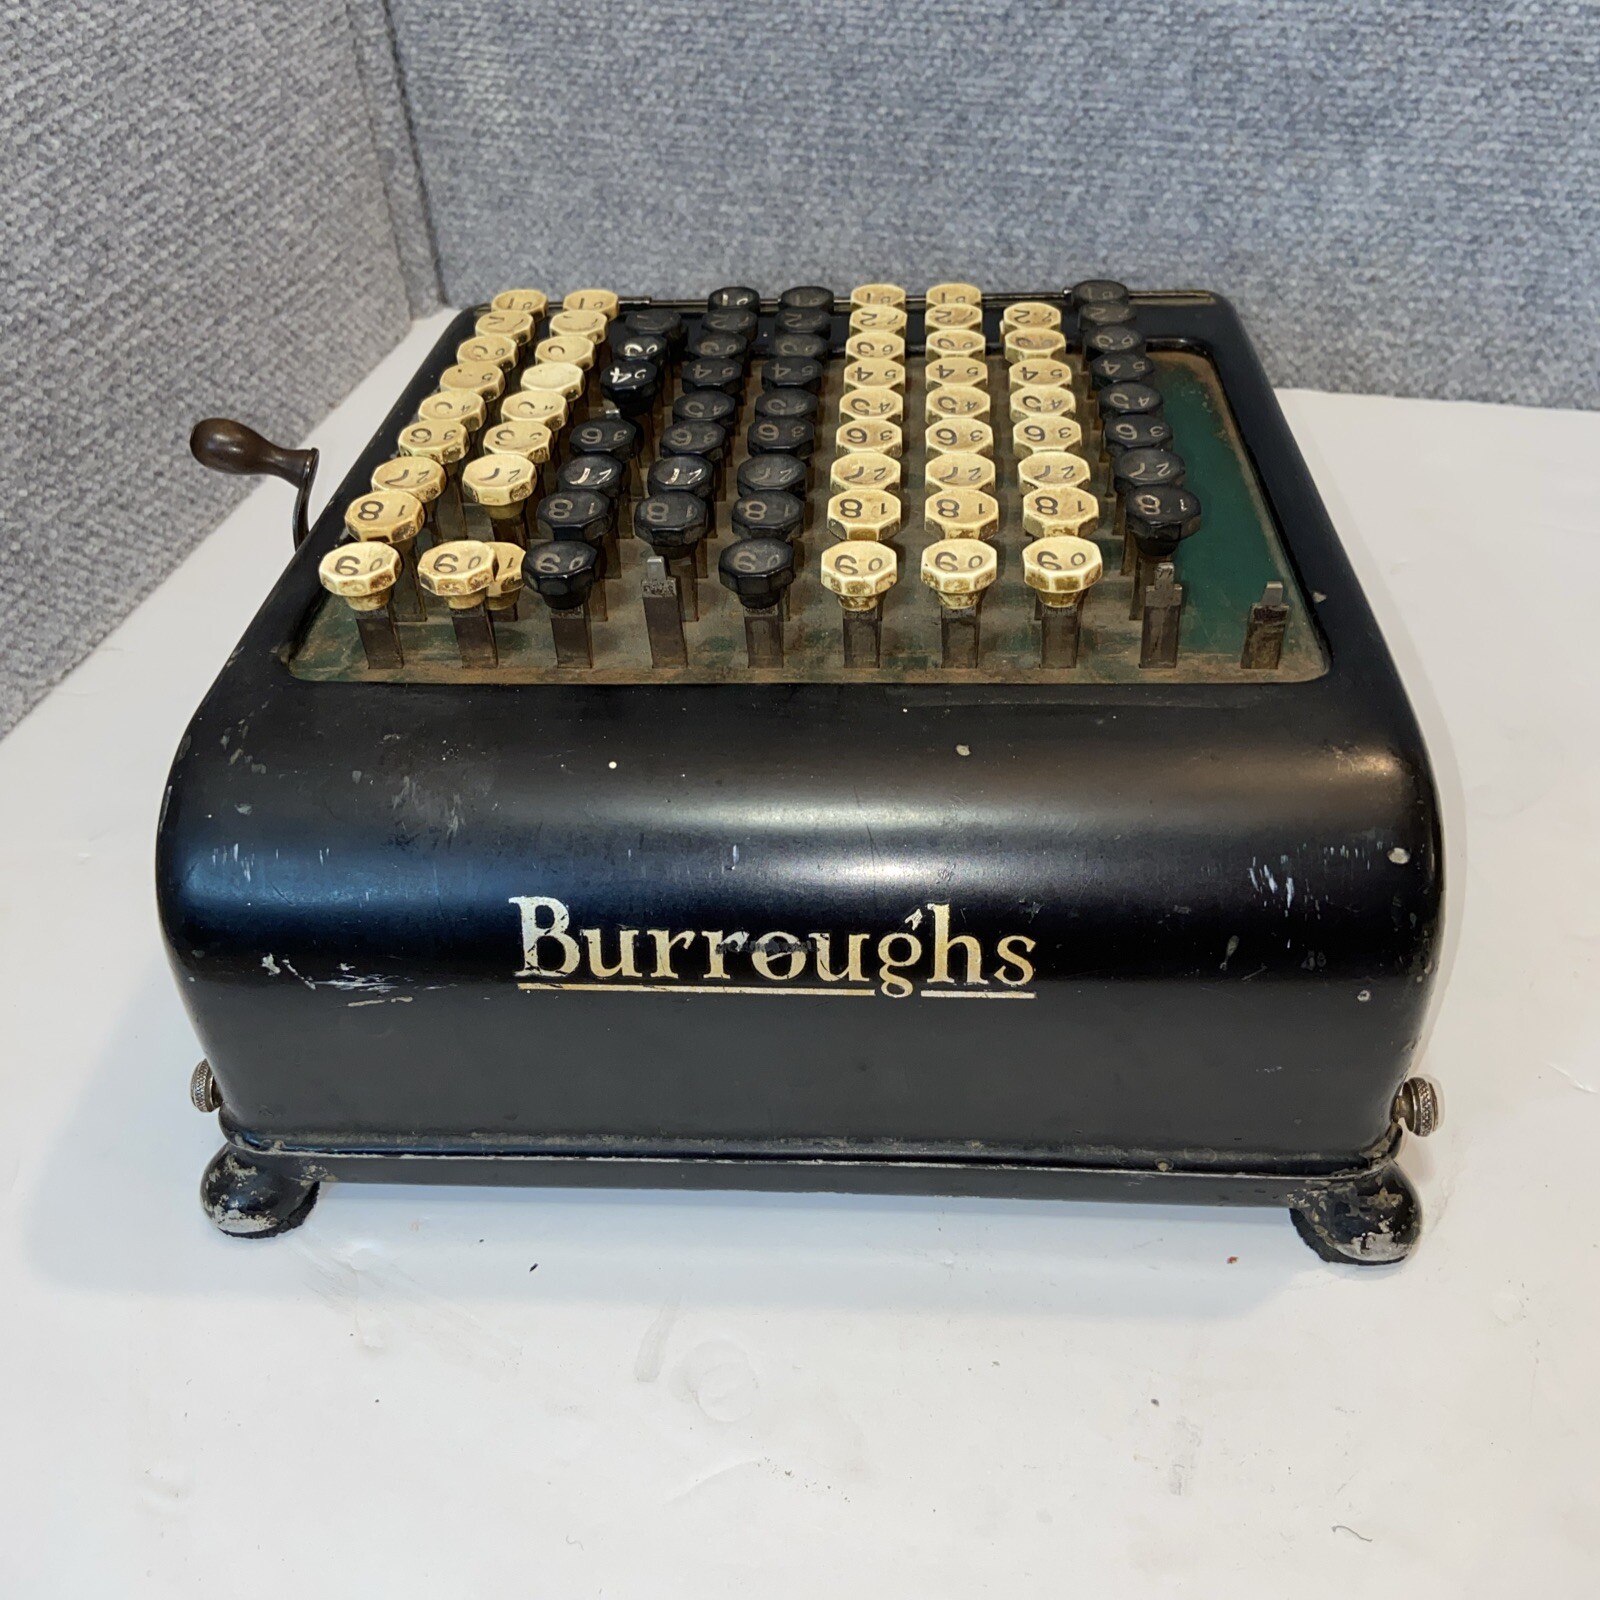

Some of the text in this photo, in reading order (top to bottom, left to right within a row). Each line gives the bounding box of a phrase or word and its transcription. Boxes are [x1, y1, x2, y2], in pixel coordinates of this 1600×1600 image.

[771, 363, 792, 379] 4
[855, 367, 874, 382] 4
[936, 364, 955, 379] 4
[1019, 367, 1039, 381] 4
[1101, 360, 1121, 375] 4
[357, 500, 384, 521] 8
[549, 499, 574, 519] 8
[646, 502, 669, 522] 8
[744, 501, 767, 520] 8
[839, 499, 888, 518] 1 8
[936, 499, 986, 518] 1 8
[1035, 496, 1086, 516] 1 8
[1136, 494, 1161, 515] 8
[868, 557, 883, 572] 0
[968, 555, 984, 569] 0
[1070, 552, 1087, 567] 0
[508, 895, 1038, 998] Burroughs
